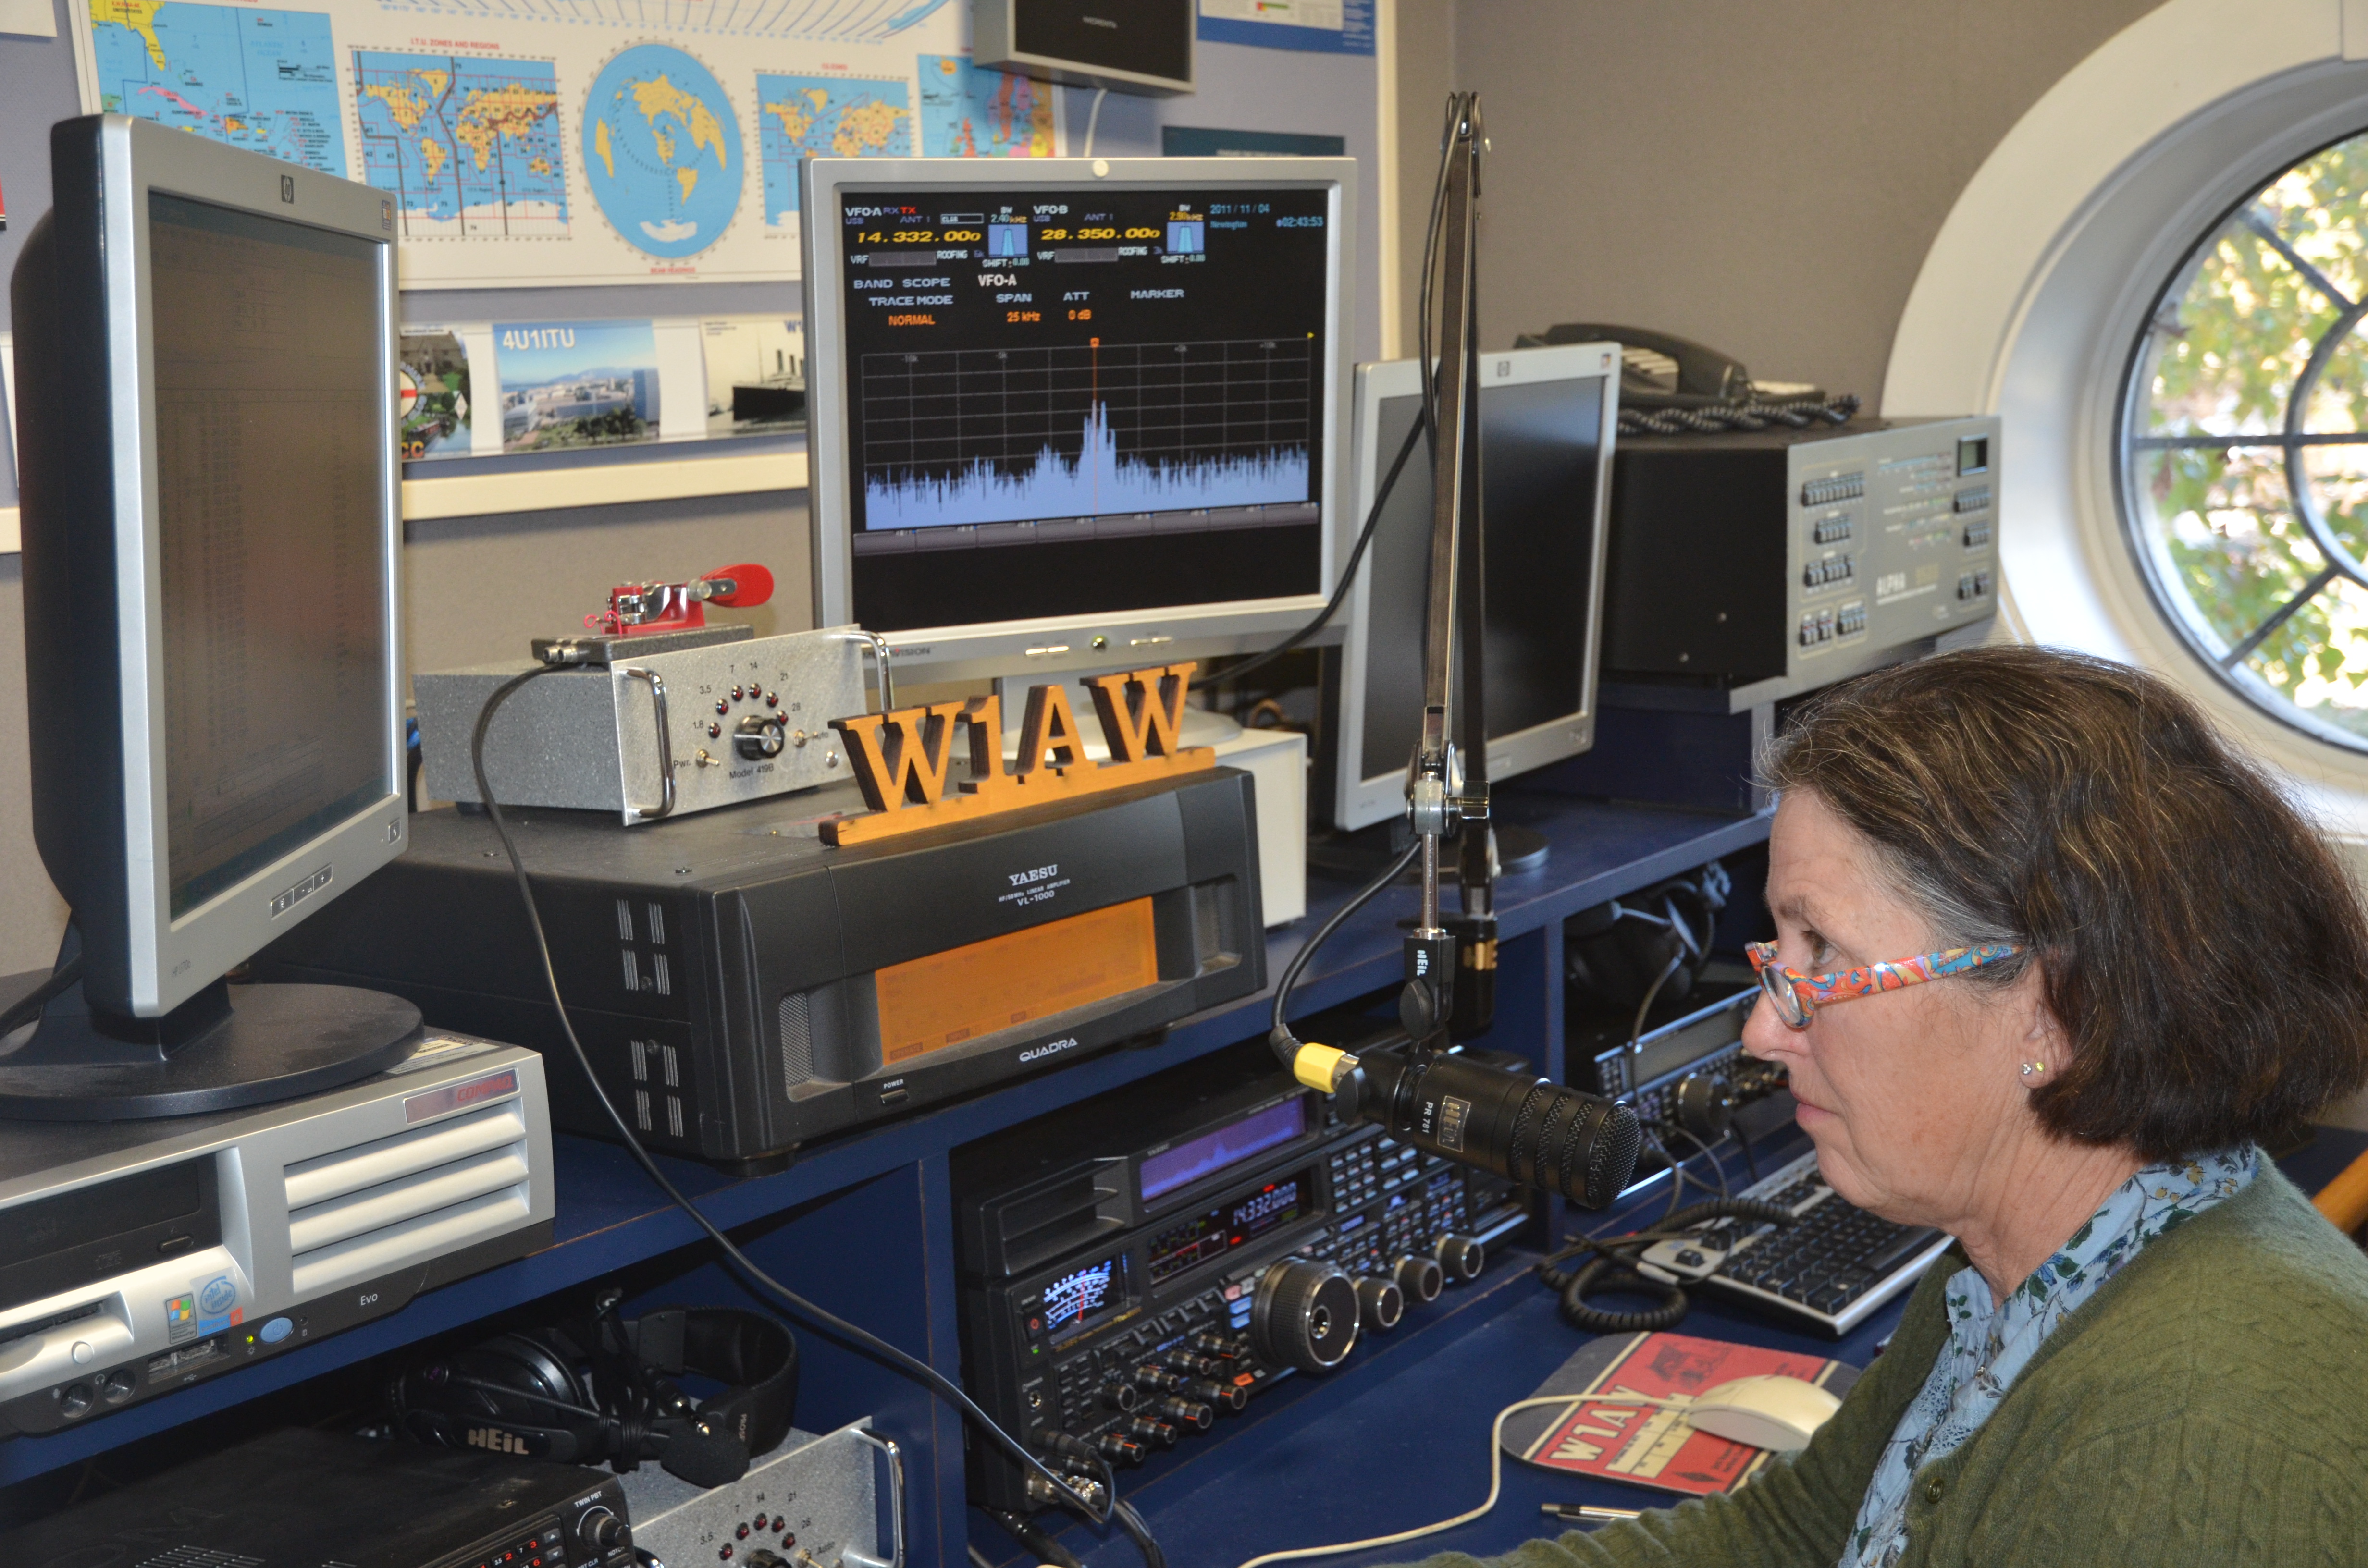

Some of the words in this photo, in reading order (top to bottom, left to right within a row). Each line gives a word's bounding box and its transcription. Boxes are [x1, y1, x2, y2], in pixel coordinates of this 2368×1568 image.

[900, 206, 916, 214] TX
[853, 279, 893, 289] BAND
[902, 277, 951, 288] SCOPE
[868, 296, 915, 306] TRACE
[916, 295, 954, 305] MODE
[995, 293, 1033, 304] SPAN
[1062, 291, 1091, 302] ATT
[1130, 289, 1185, 300] MARKER
[888, 314, 937, 327] NORMAL
[730, 665, 734, 673] 7
[750, 662, 758, 670] 14
[780, 673, 788, 681] 21
[699, 685, 712, 695] 3.5
[693, 720, 704, 729] 1.8
[827, 661, 1197, 814] W1AW
[729, 769, 753, 779] Model
[1008, 864, 1058, 886] YAESU
[1026, 885, 1045, 895] LINEAR
[1046, 878, 1071, 890] AMPLIFIER
[1016, 890, 1055, 906] VL-1000
[1019, 1037, 1078, 1062] QUADRA
[457, 1075, 514, 1102] COMPAQ
[883, 1078, 904, 1089] POWER
[1424, 1101, 1433, 1115] PR
[1421, 1118, 1431, 1134] 781
[204, 1283, 221, 1303] intel
[211, 1289, 233, 1310] inside
[360, 1293, 378, 1306] Evo
[574, 1496, 591, 1508] TWIN
[590, 1490, 602, 1501] PBT
[700, 1531, 714, 1545] 3.5
[530, 1540, 537, 1549] 3
[494, 1557, 503, 1566] 3.5
[505, 1552, 513, 1561] 2
[533, 1558, 541, 1567] 6
[588, 1557, 599, 1567] CLR
